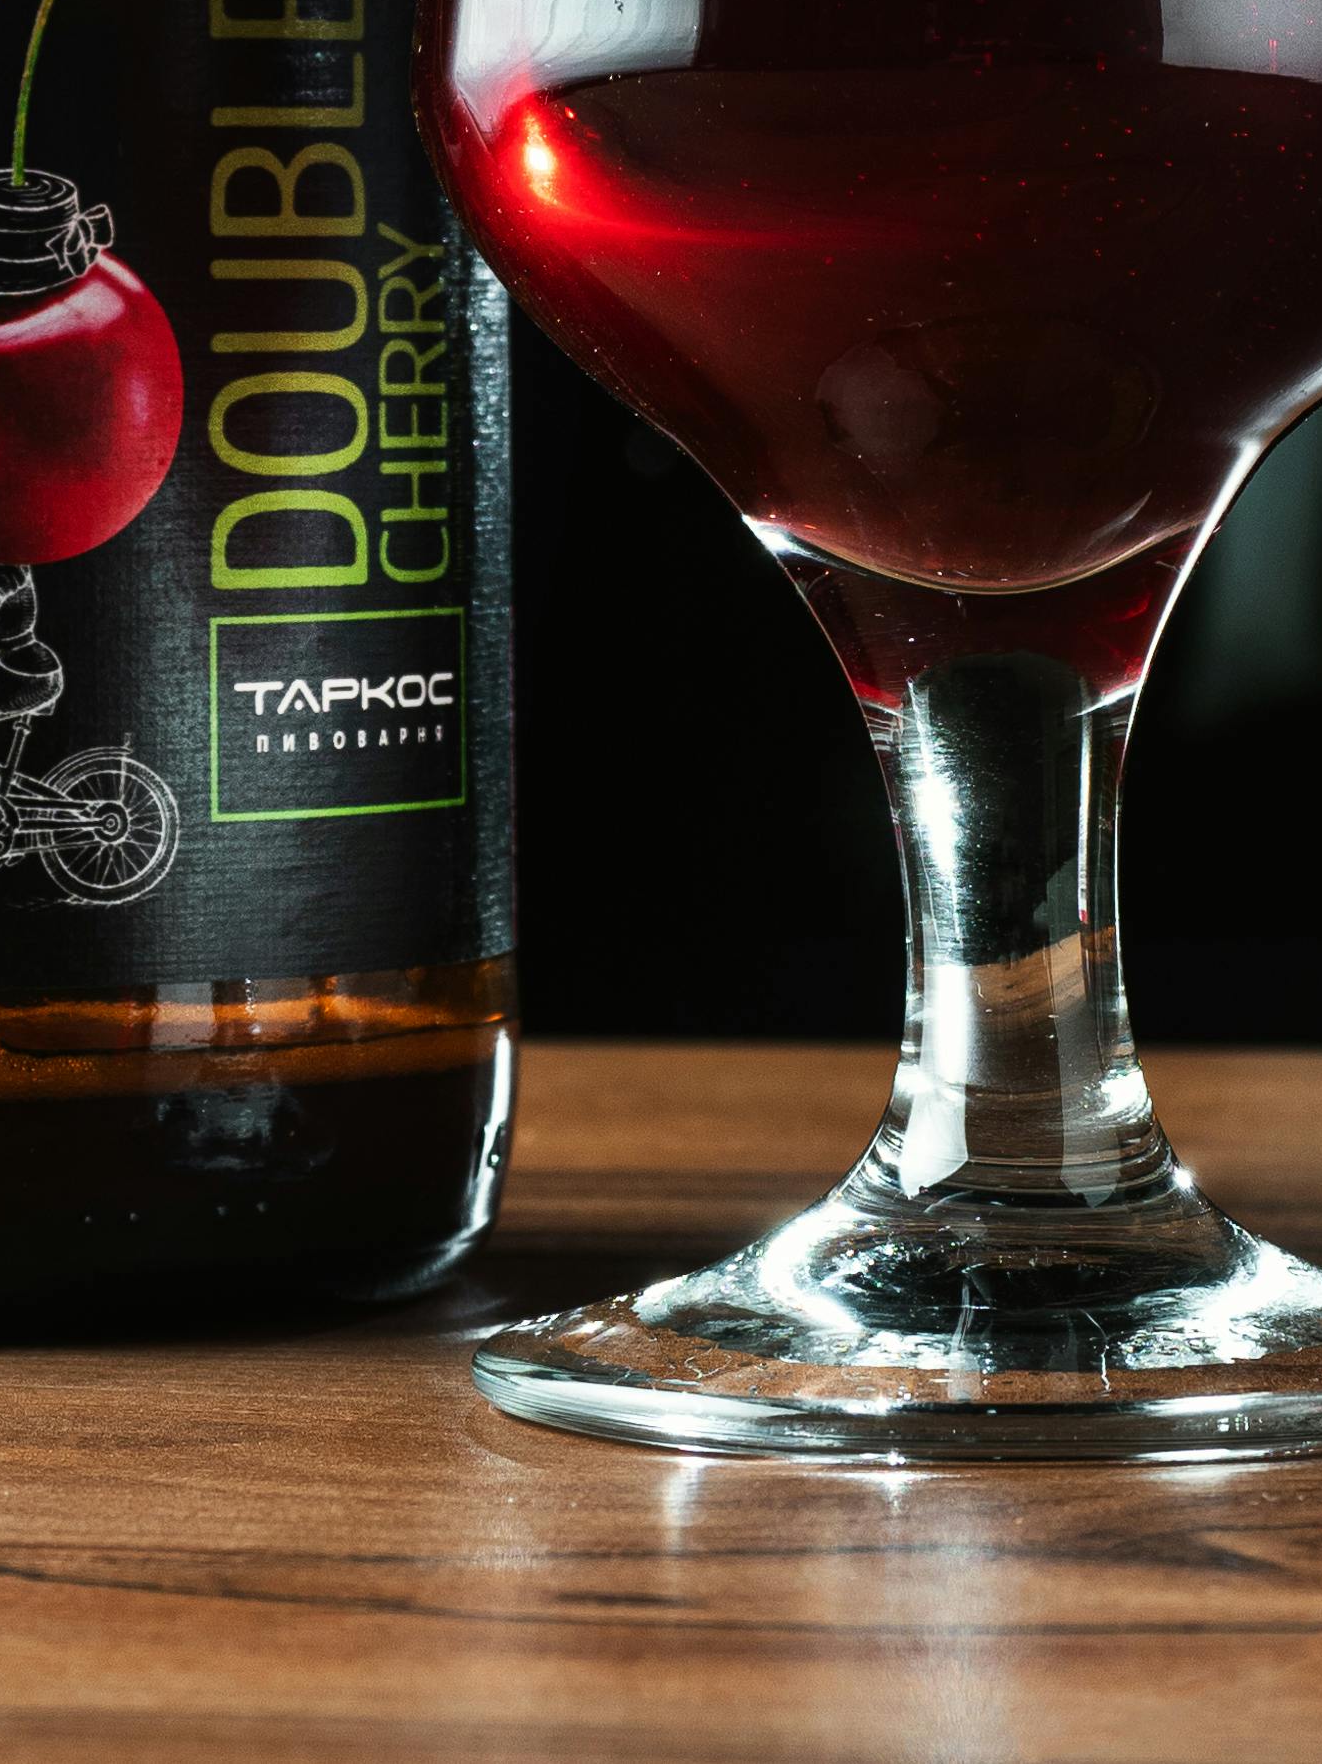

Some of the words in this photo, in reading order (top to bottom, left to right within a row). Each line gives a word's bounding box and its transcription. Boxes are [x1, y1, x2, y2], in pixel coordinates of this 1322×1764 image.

[377, 221, 452, 584] CHERRY
[233, 672, 455, 716] ТАРКОС
[255, 725, 444, 754] ПИВОВАРНЯ
